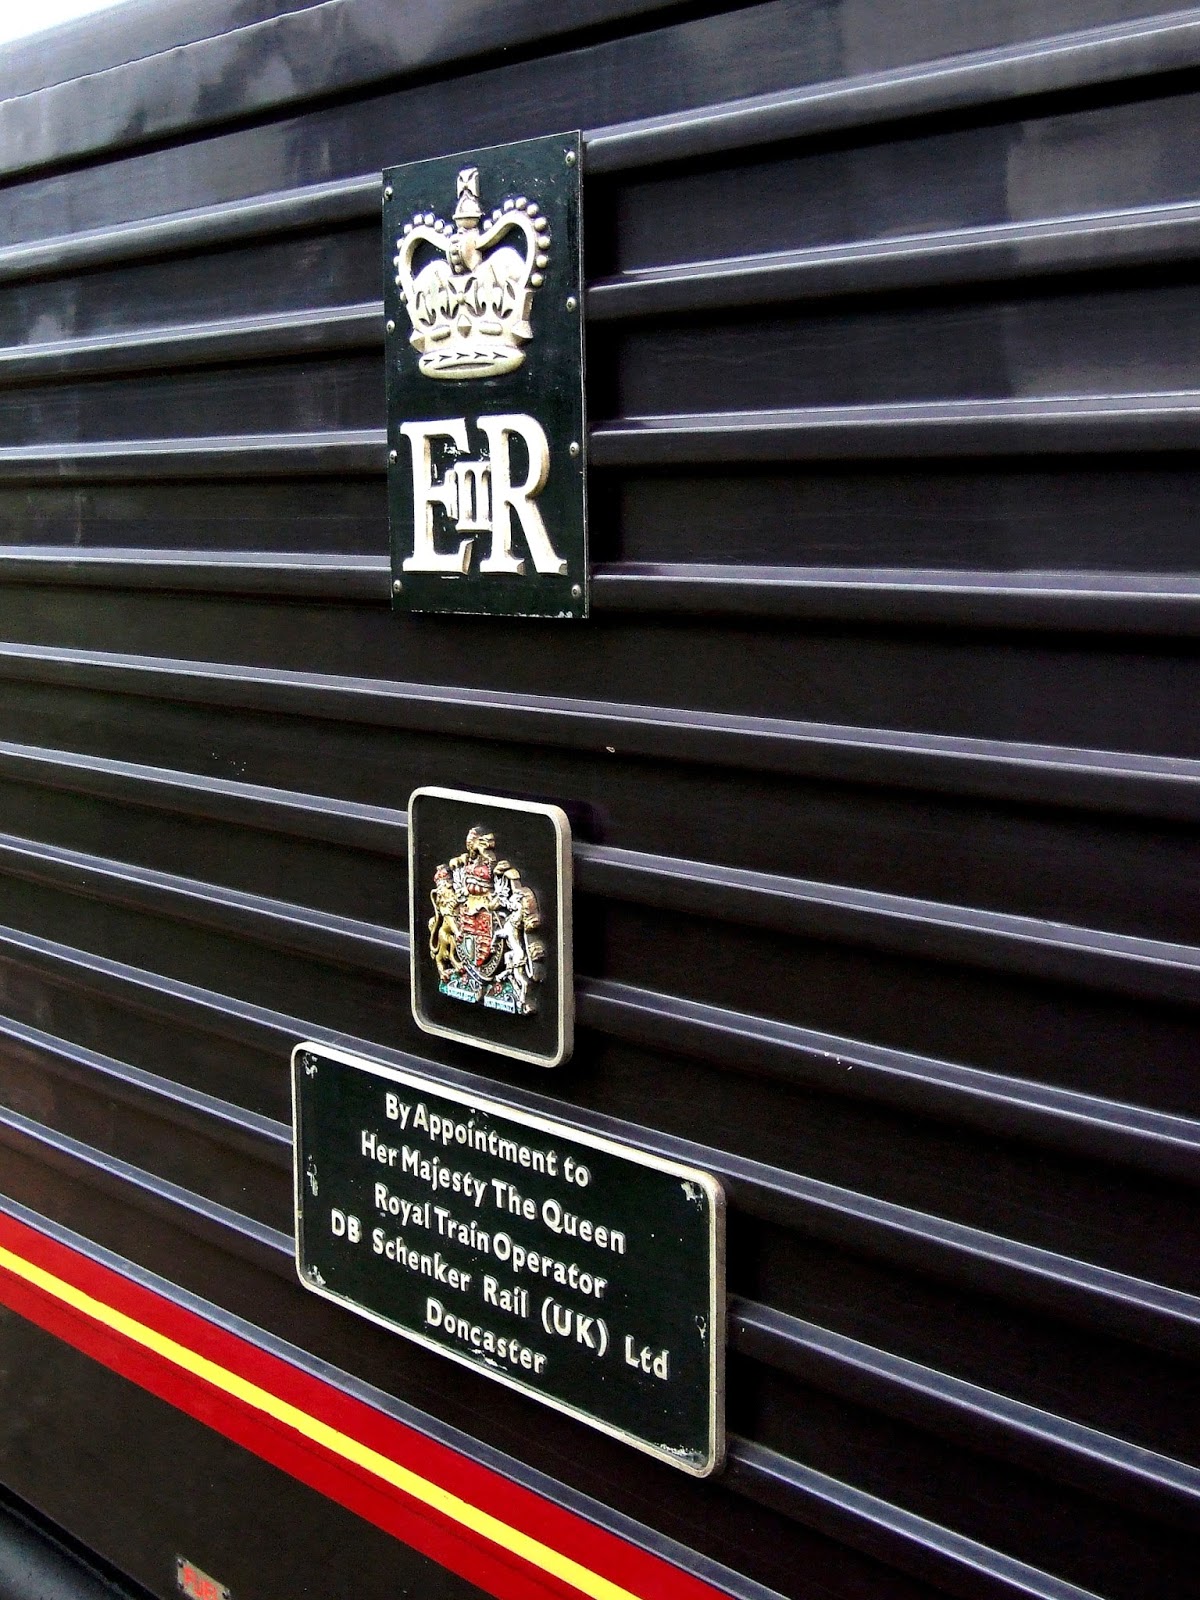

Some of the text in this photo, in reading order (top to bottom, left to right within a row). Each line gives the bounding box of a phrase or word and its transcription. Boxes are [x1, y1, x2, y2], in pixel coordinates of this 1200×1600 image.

[361, 1130, 627, 1255] Her Majesty The Queen
[385, 1092, 591, 1188] By Appointment to
[331, 1208, 670, 1382] DB Schenker Rail (UK) Ltd
[374, 1182, 608, 1300] Royal Train Operator
[426, 1296, 548, 1375] Doncaster
